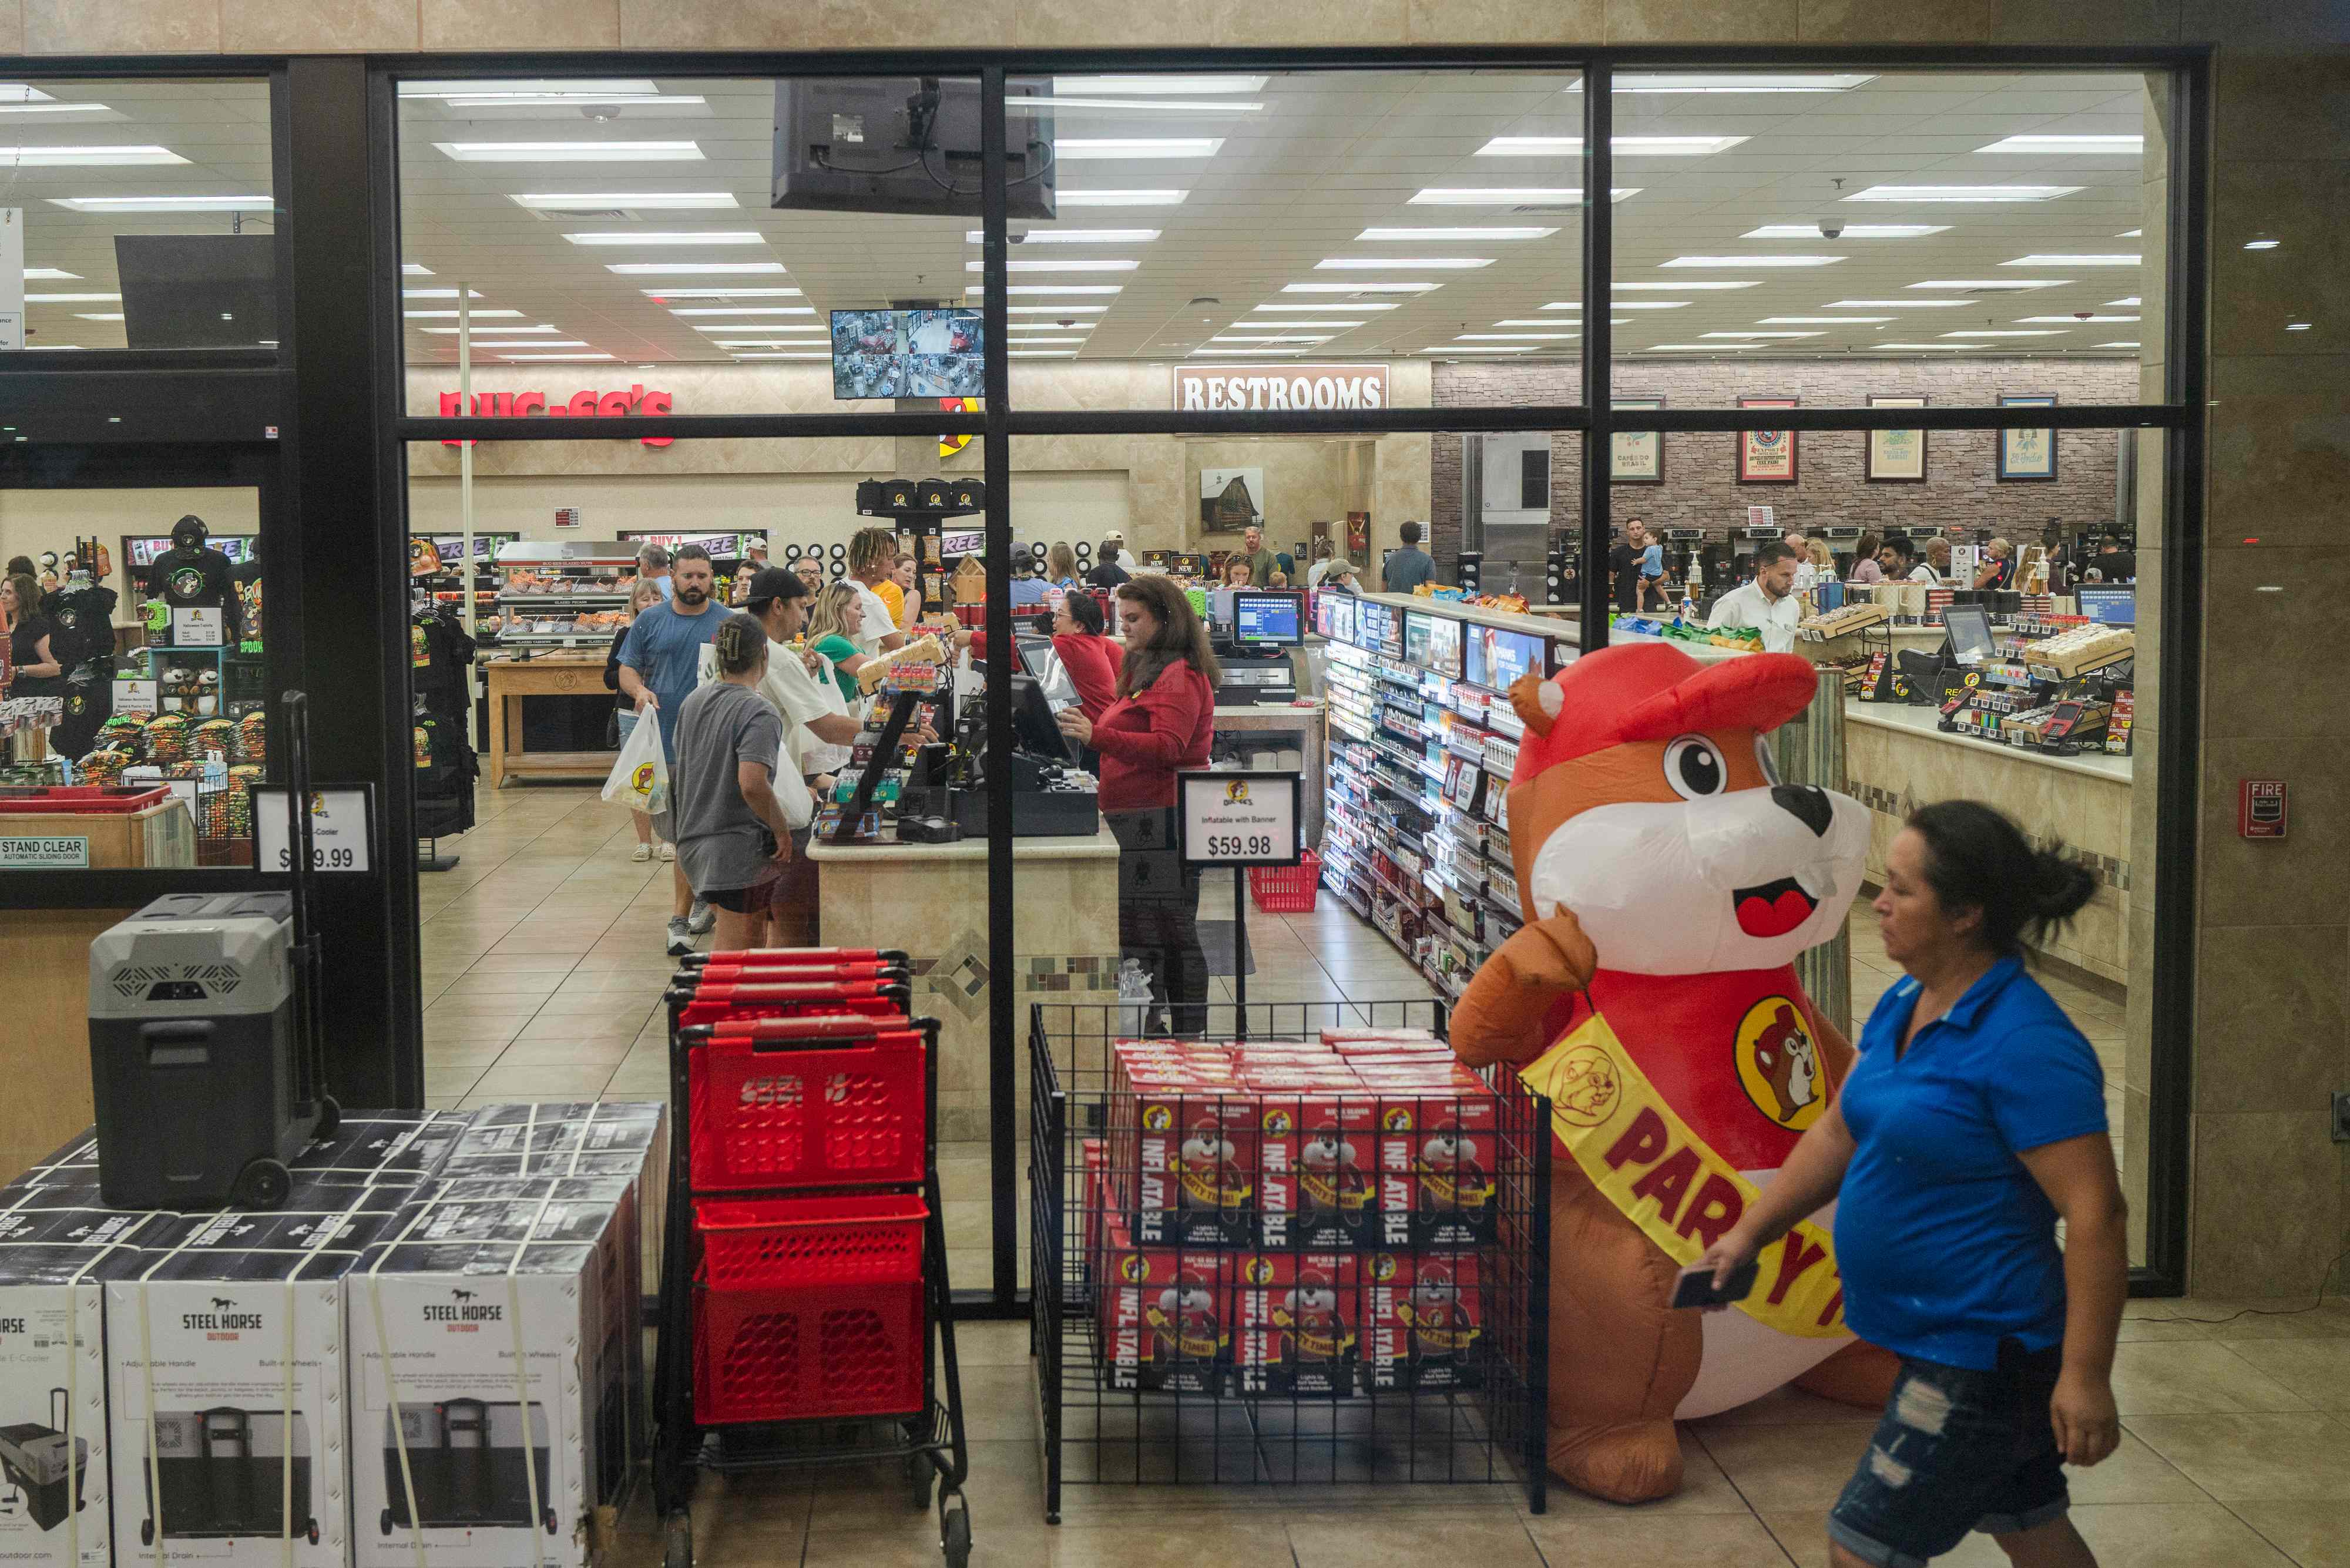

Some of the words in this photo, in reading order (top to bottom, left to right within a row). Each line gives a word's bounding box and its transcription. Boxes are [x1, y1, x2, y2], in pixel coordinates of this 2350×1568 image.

[1183, 377, 1381, 411] RESTROOMS
[439, 538, 486, 559] FRE
[650, 535, 674, 546] BUY
[941, 534, 981, 553] REE
[2252, 784, 2283, 795] FIRE
[2, 841, 41, 852] STAND
[43, 841, 82, 852] CLEAR
[1208, 835, 1271, 857] $59.98
[279, 848, 353, 869] $9.99
[1603, 1106, 1827, 1306] PARY
[423, 1305, 458, 1321] STEEL
[461, 1305, 502, 1321] HORSE
[0, 1318, 25, 1334] RSE
[183, 1314, 219, 1329] STEEL
[221, 1314, 262, 1329] HORSE
[446, 1324, 479, 1332] OUTDOOR
[207, 1332, 240, 1341] OUTDOOR
[126, 1360, 166, 1368] Adjuable
